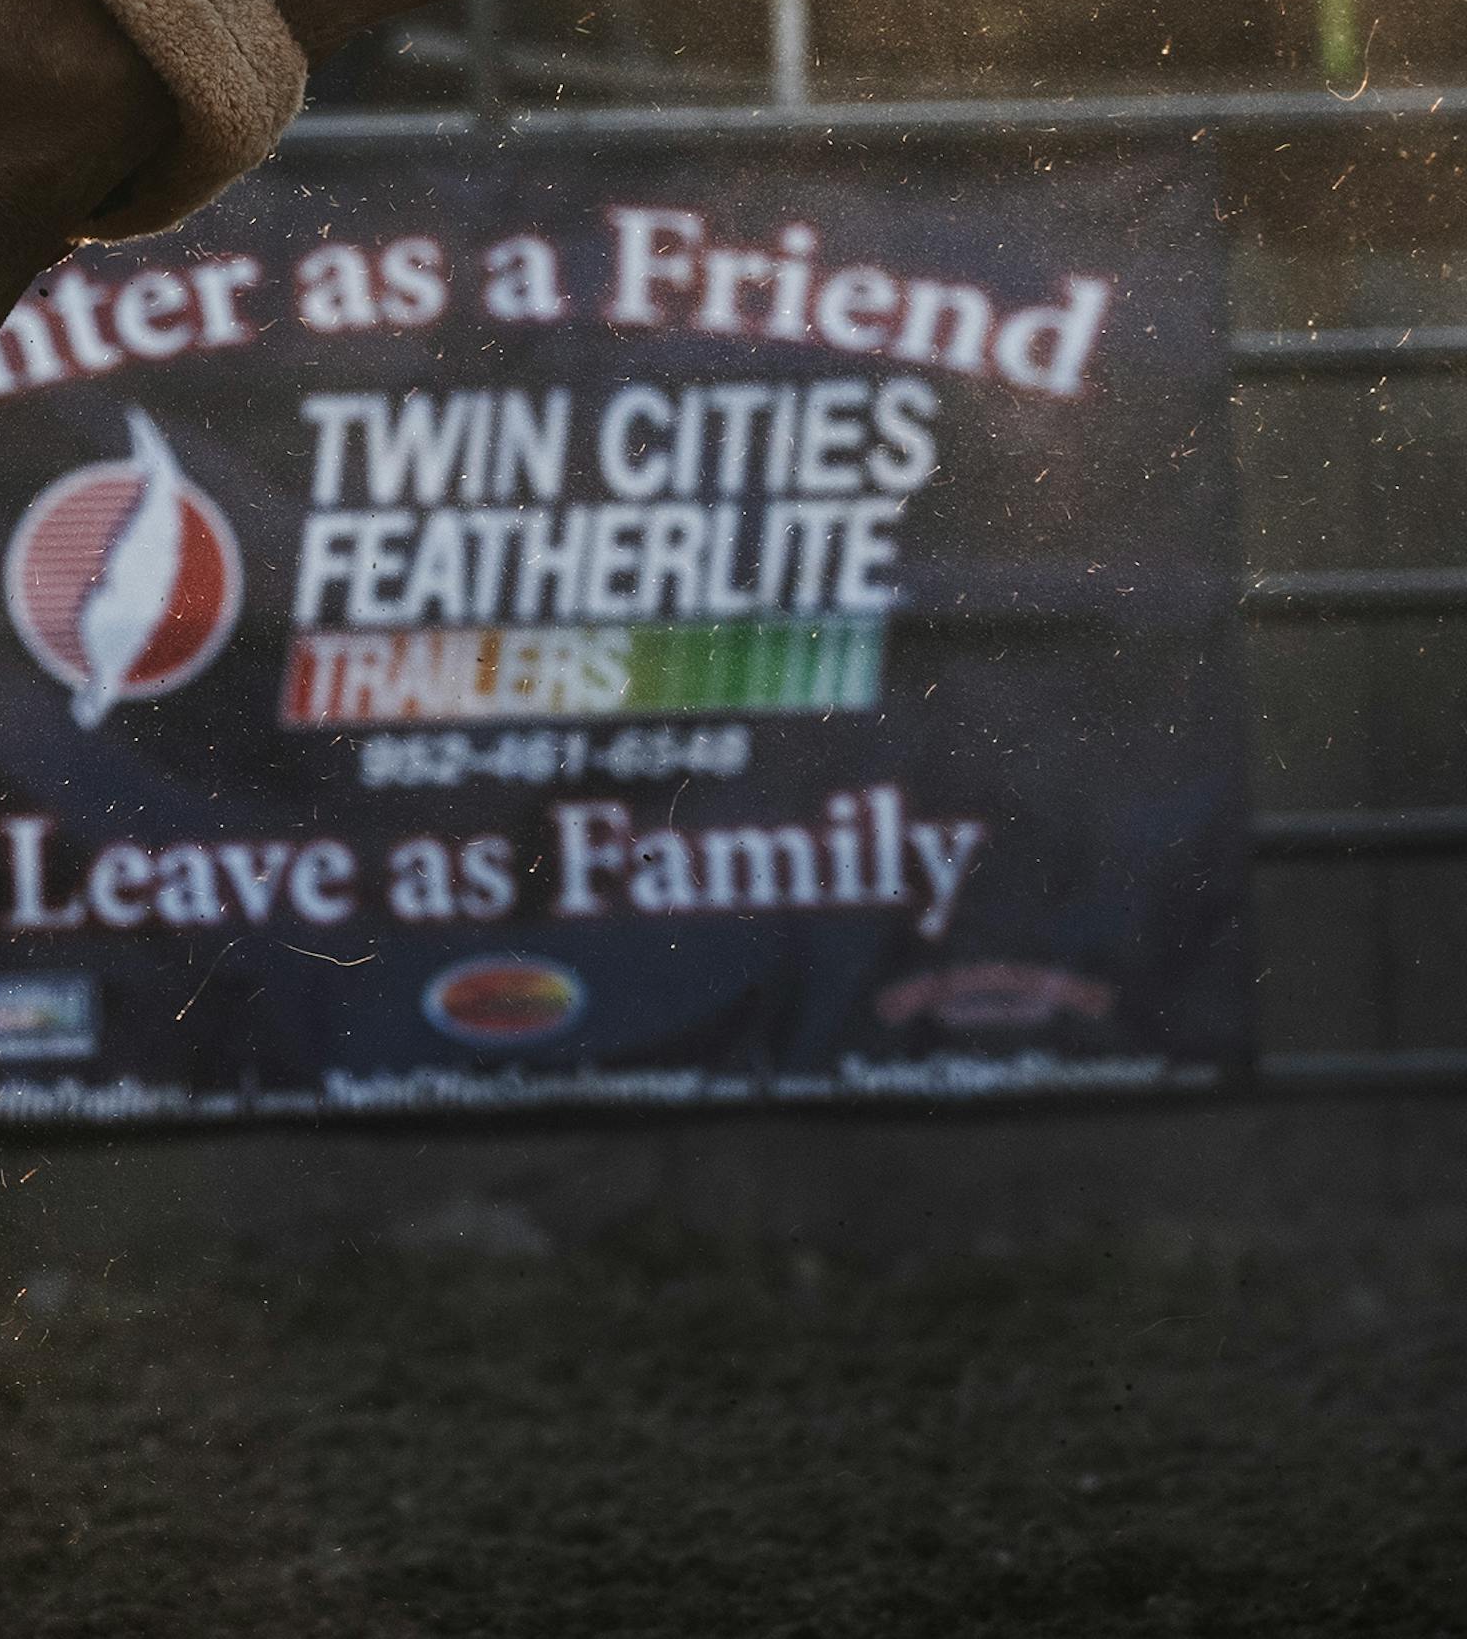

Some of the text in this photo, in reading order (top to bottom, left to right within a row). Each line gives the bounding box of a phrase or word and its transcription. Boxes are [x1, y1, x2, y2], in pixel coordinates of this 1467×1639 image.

[298, 236, 446, 333] as
[484, 237, 562, 321] a
[606, 206, 1112, 394] Friend
[301, 377, 938, 509] TWIN CITIES
[291, 496, 900, 627] FEATHERLITE
[307, 625, 634, 720] TRAILERS
[4, 784, 984, 939] Leave as Family
